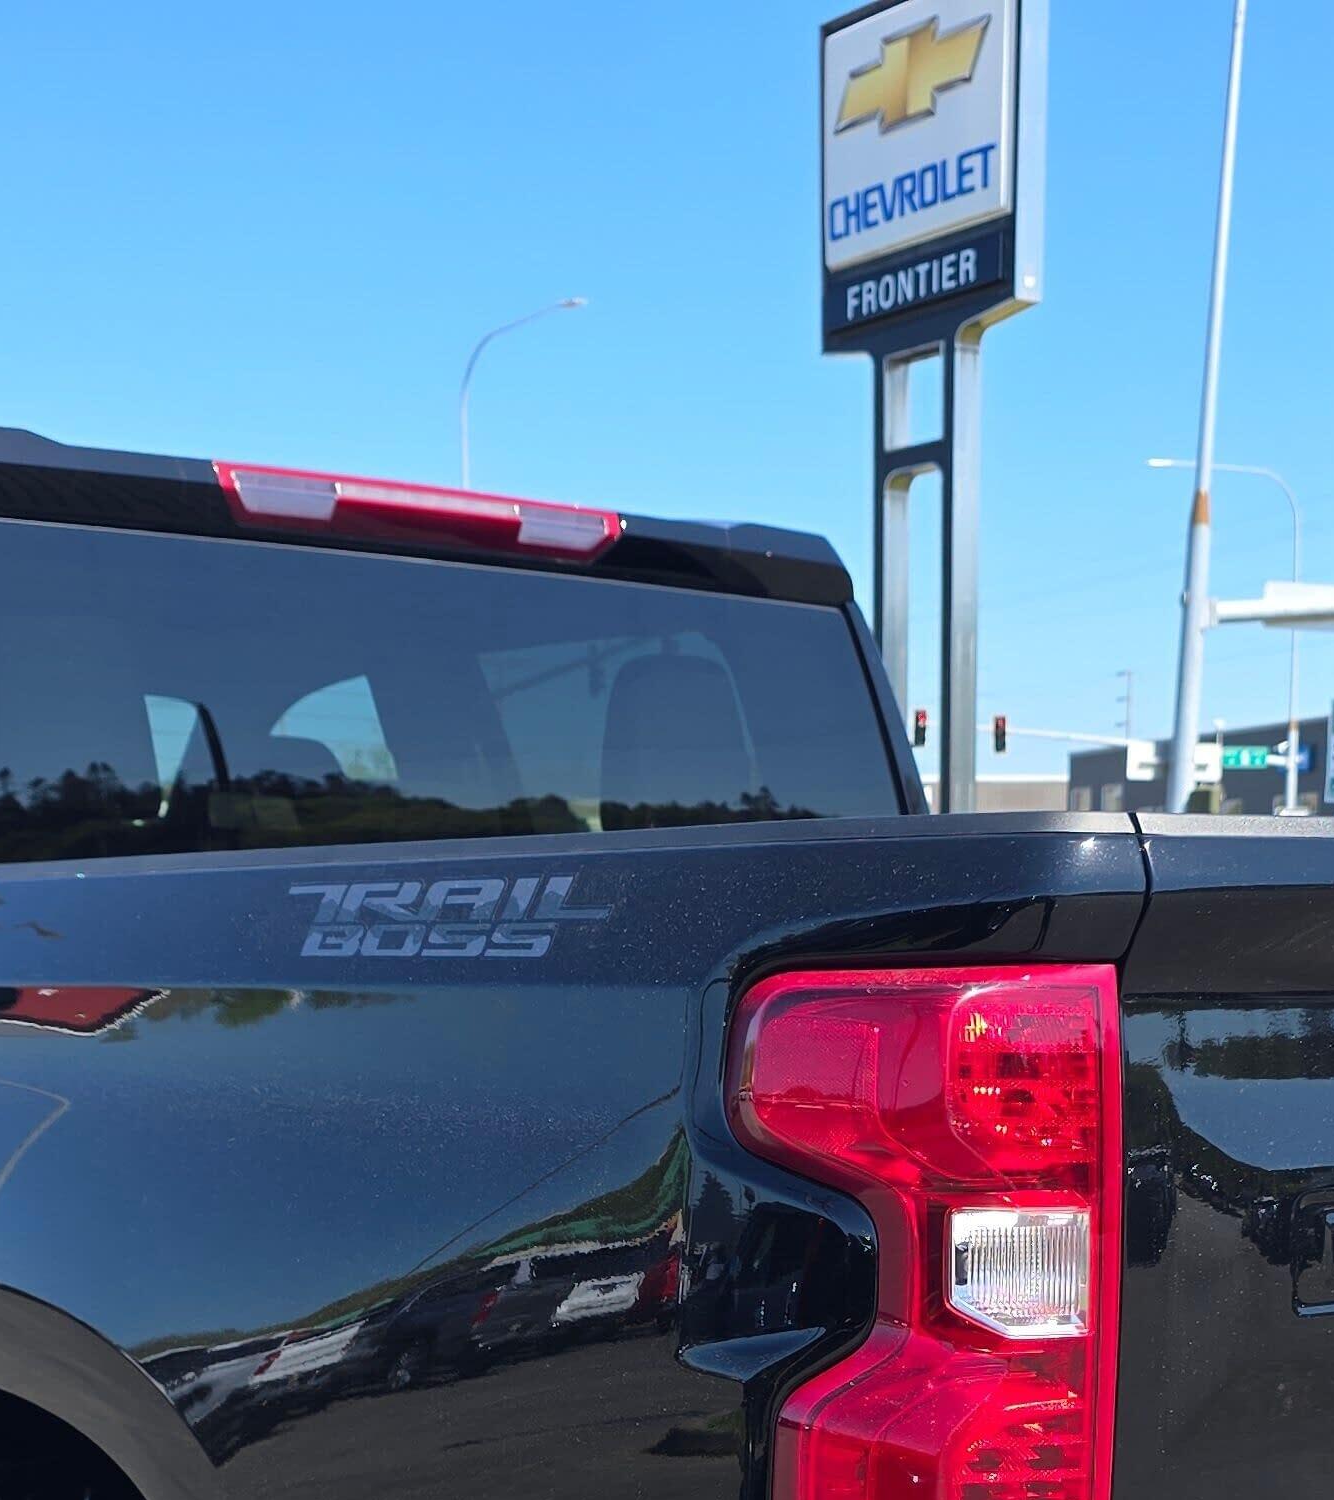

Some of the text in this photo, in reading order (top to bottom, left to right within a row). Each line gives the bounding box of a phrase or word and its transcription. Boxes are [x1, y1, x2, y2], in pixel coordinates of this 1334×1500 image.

[828, 141, 997, 242] CHEVROLET
[846, 247, 978, 321] FRONTIER
[288, 874, 614, 923] TRAIL
[300, 921, 560, 957] BOSS
